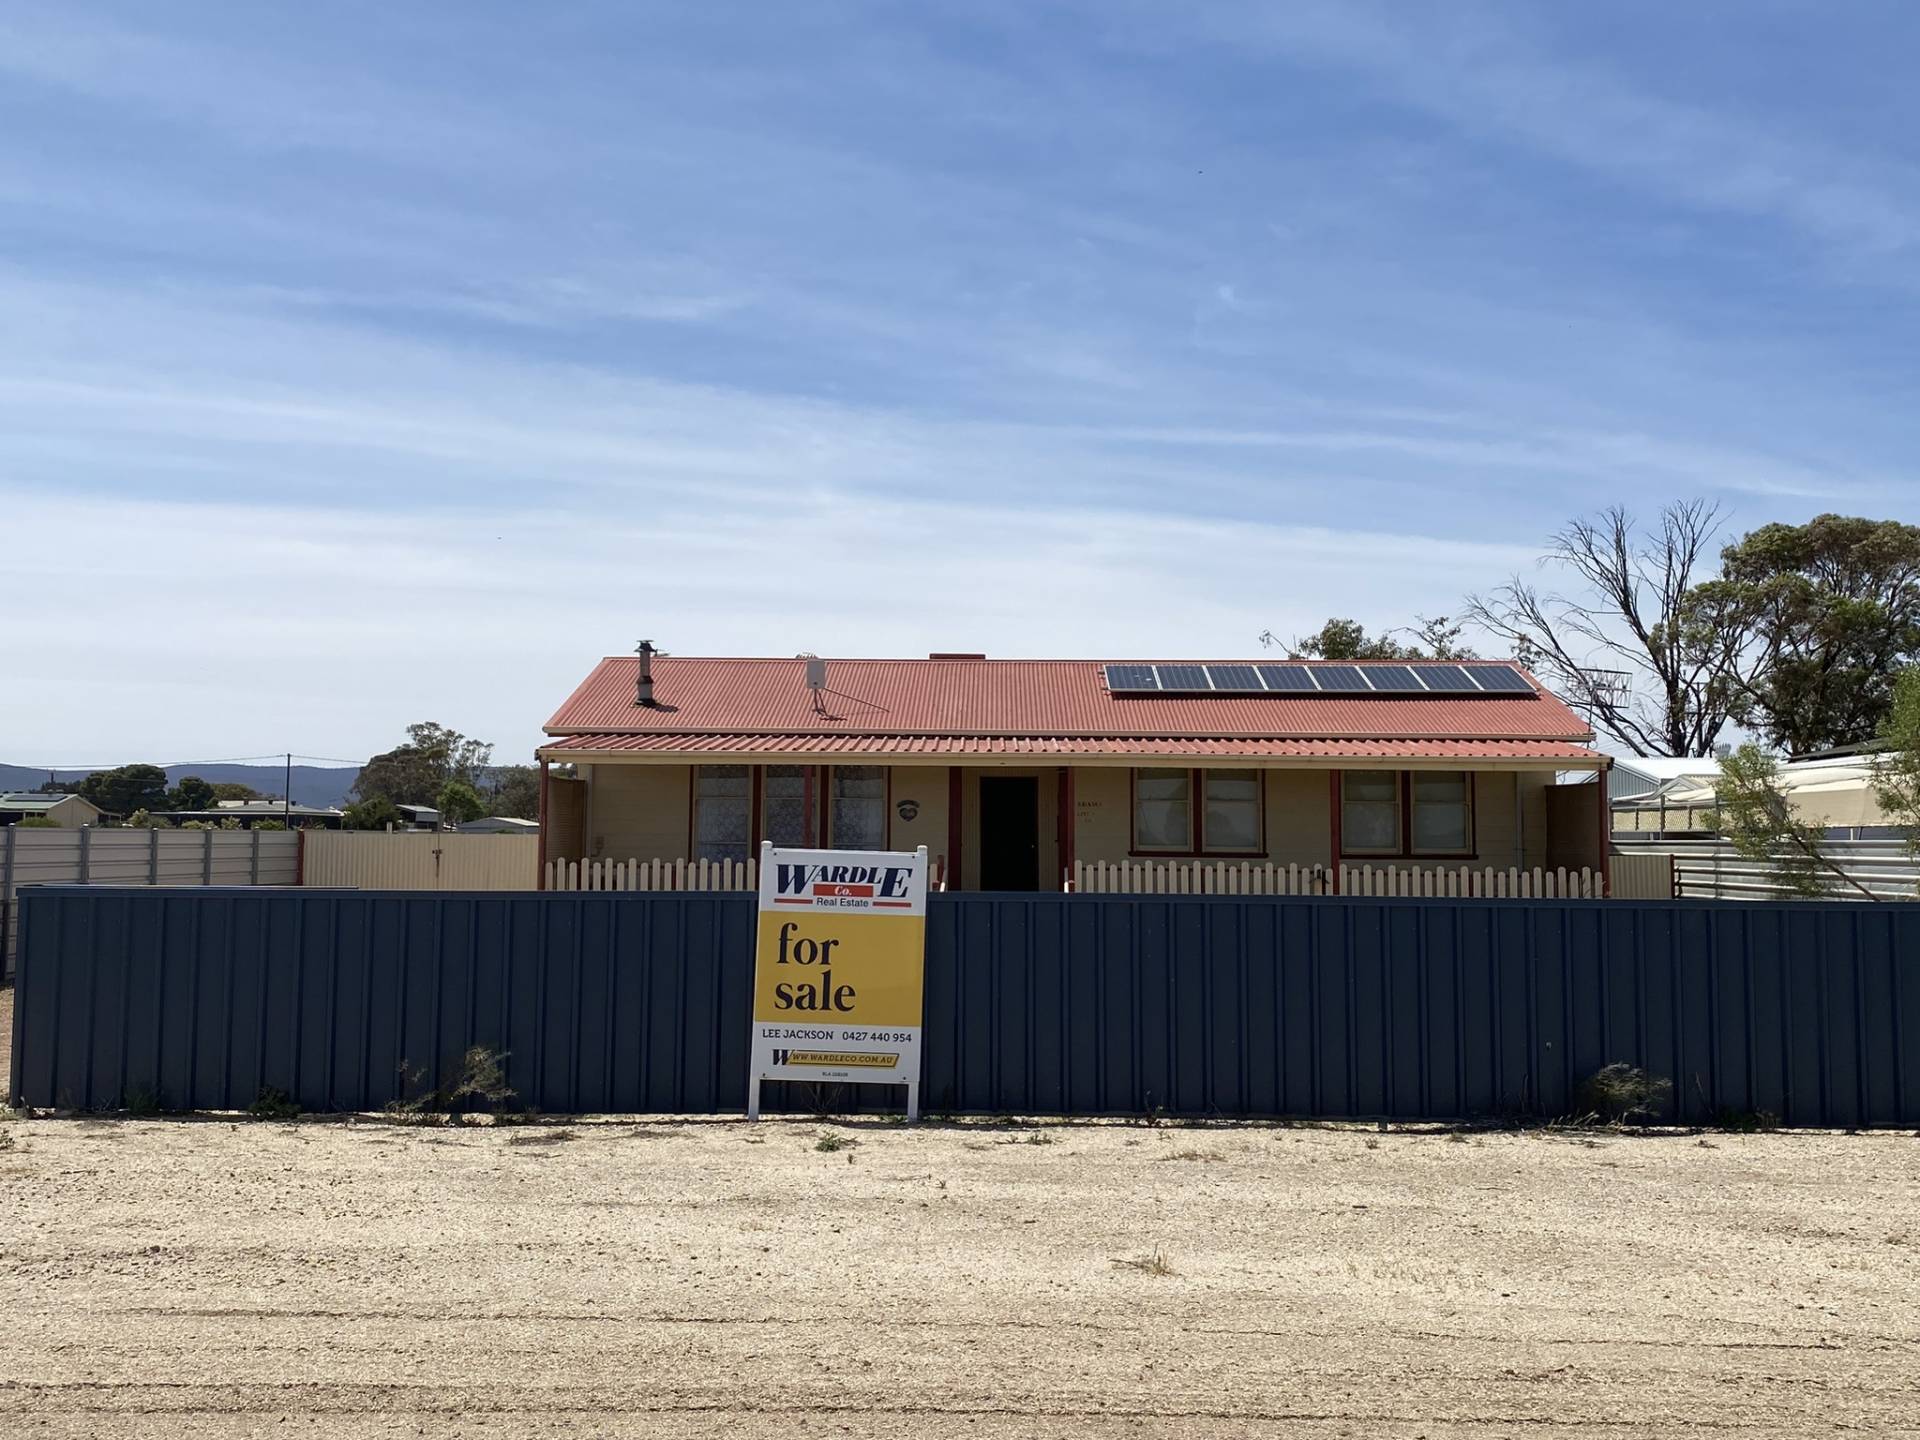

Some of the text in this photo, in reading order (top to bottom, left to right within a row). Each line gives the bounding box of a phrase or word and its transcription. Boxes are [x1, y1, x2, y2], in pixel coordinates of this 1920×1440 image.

[776, 864, 913, 898] WARDLE
[834, 884, 852, 896] Co.
[816, 897, 869, 908] Real Estate
[776, 922, 839, 965] for
[774, 969, 856, 1012] sale
[762, 1029, 912, 1043] LEE JACKSON 0427 440 954
